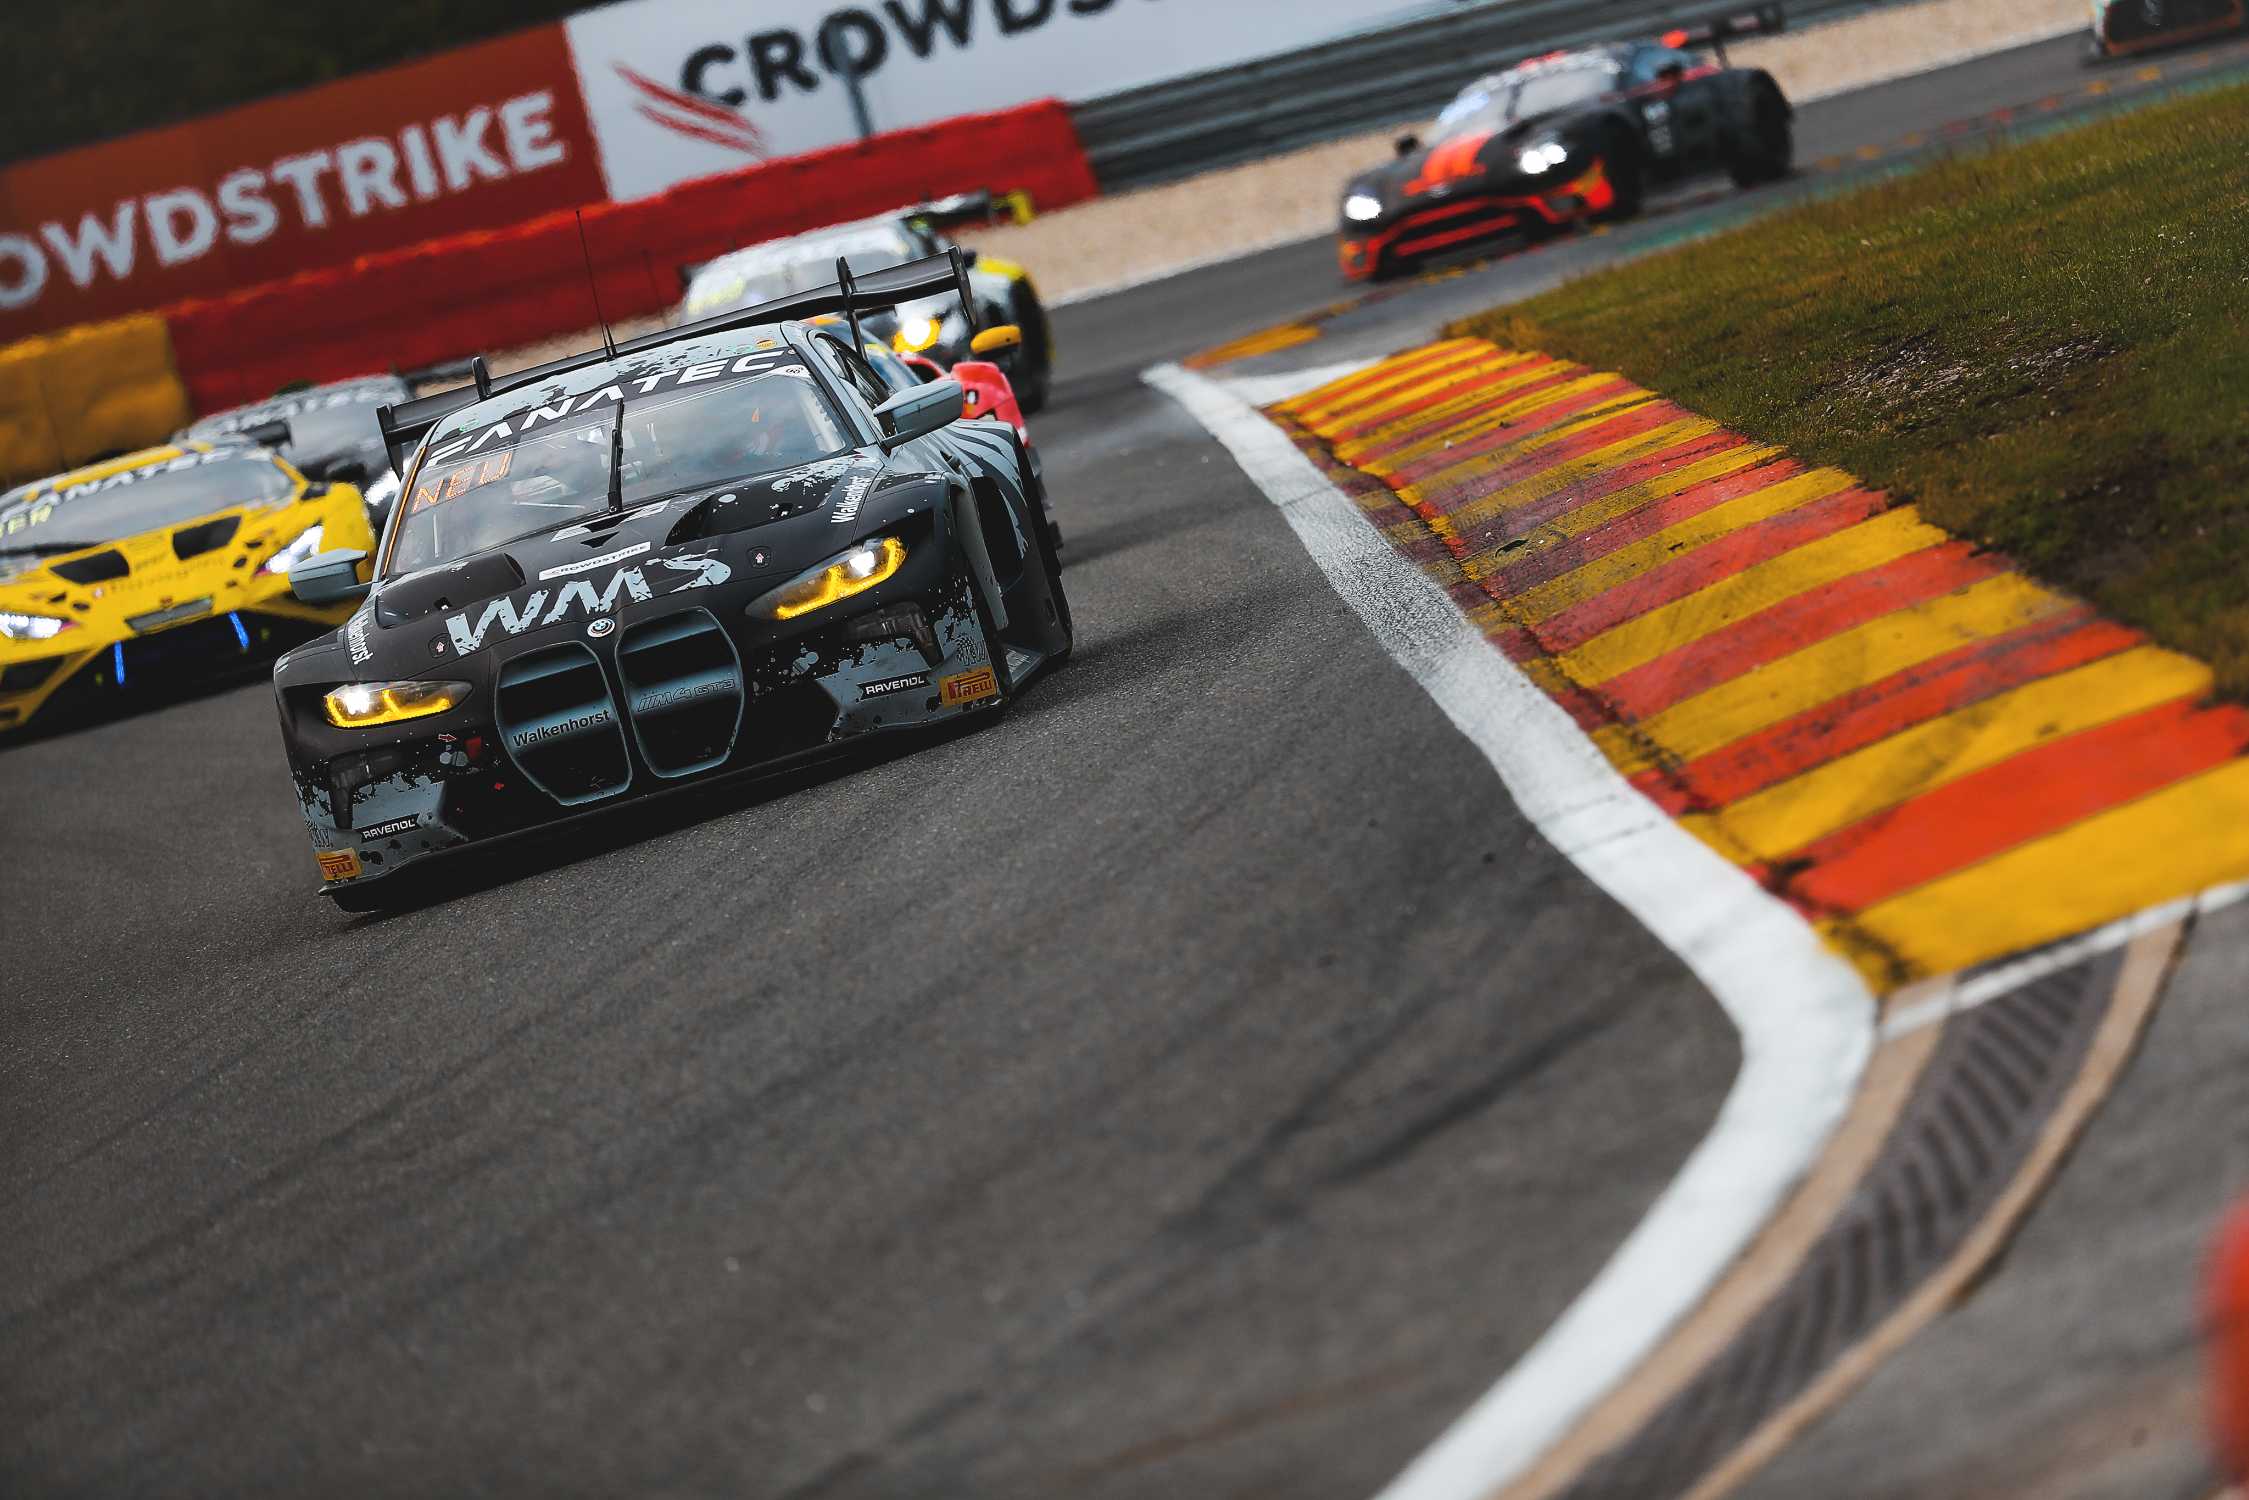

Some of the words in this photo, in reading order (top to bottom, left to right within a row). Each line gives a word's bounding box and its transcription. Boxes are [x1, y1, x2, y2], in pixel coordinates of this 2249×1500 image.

[425, 350, 785, 468] FANATEC
[411, 451, 513, 513] NEU
[549, 544, 648, 576] CROWDSTRIKE
[445, 549, 731, 656] WMS
[865, 676, 925, 695] RAVENOL
[947, 671, 994, 699] PIRELLI
[513, 709, 610, 747] Walkenhorst
[362, 819, 416, 839] RAVENOL
